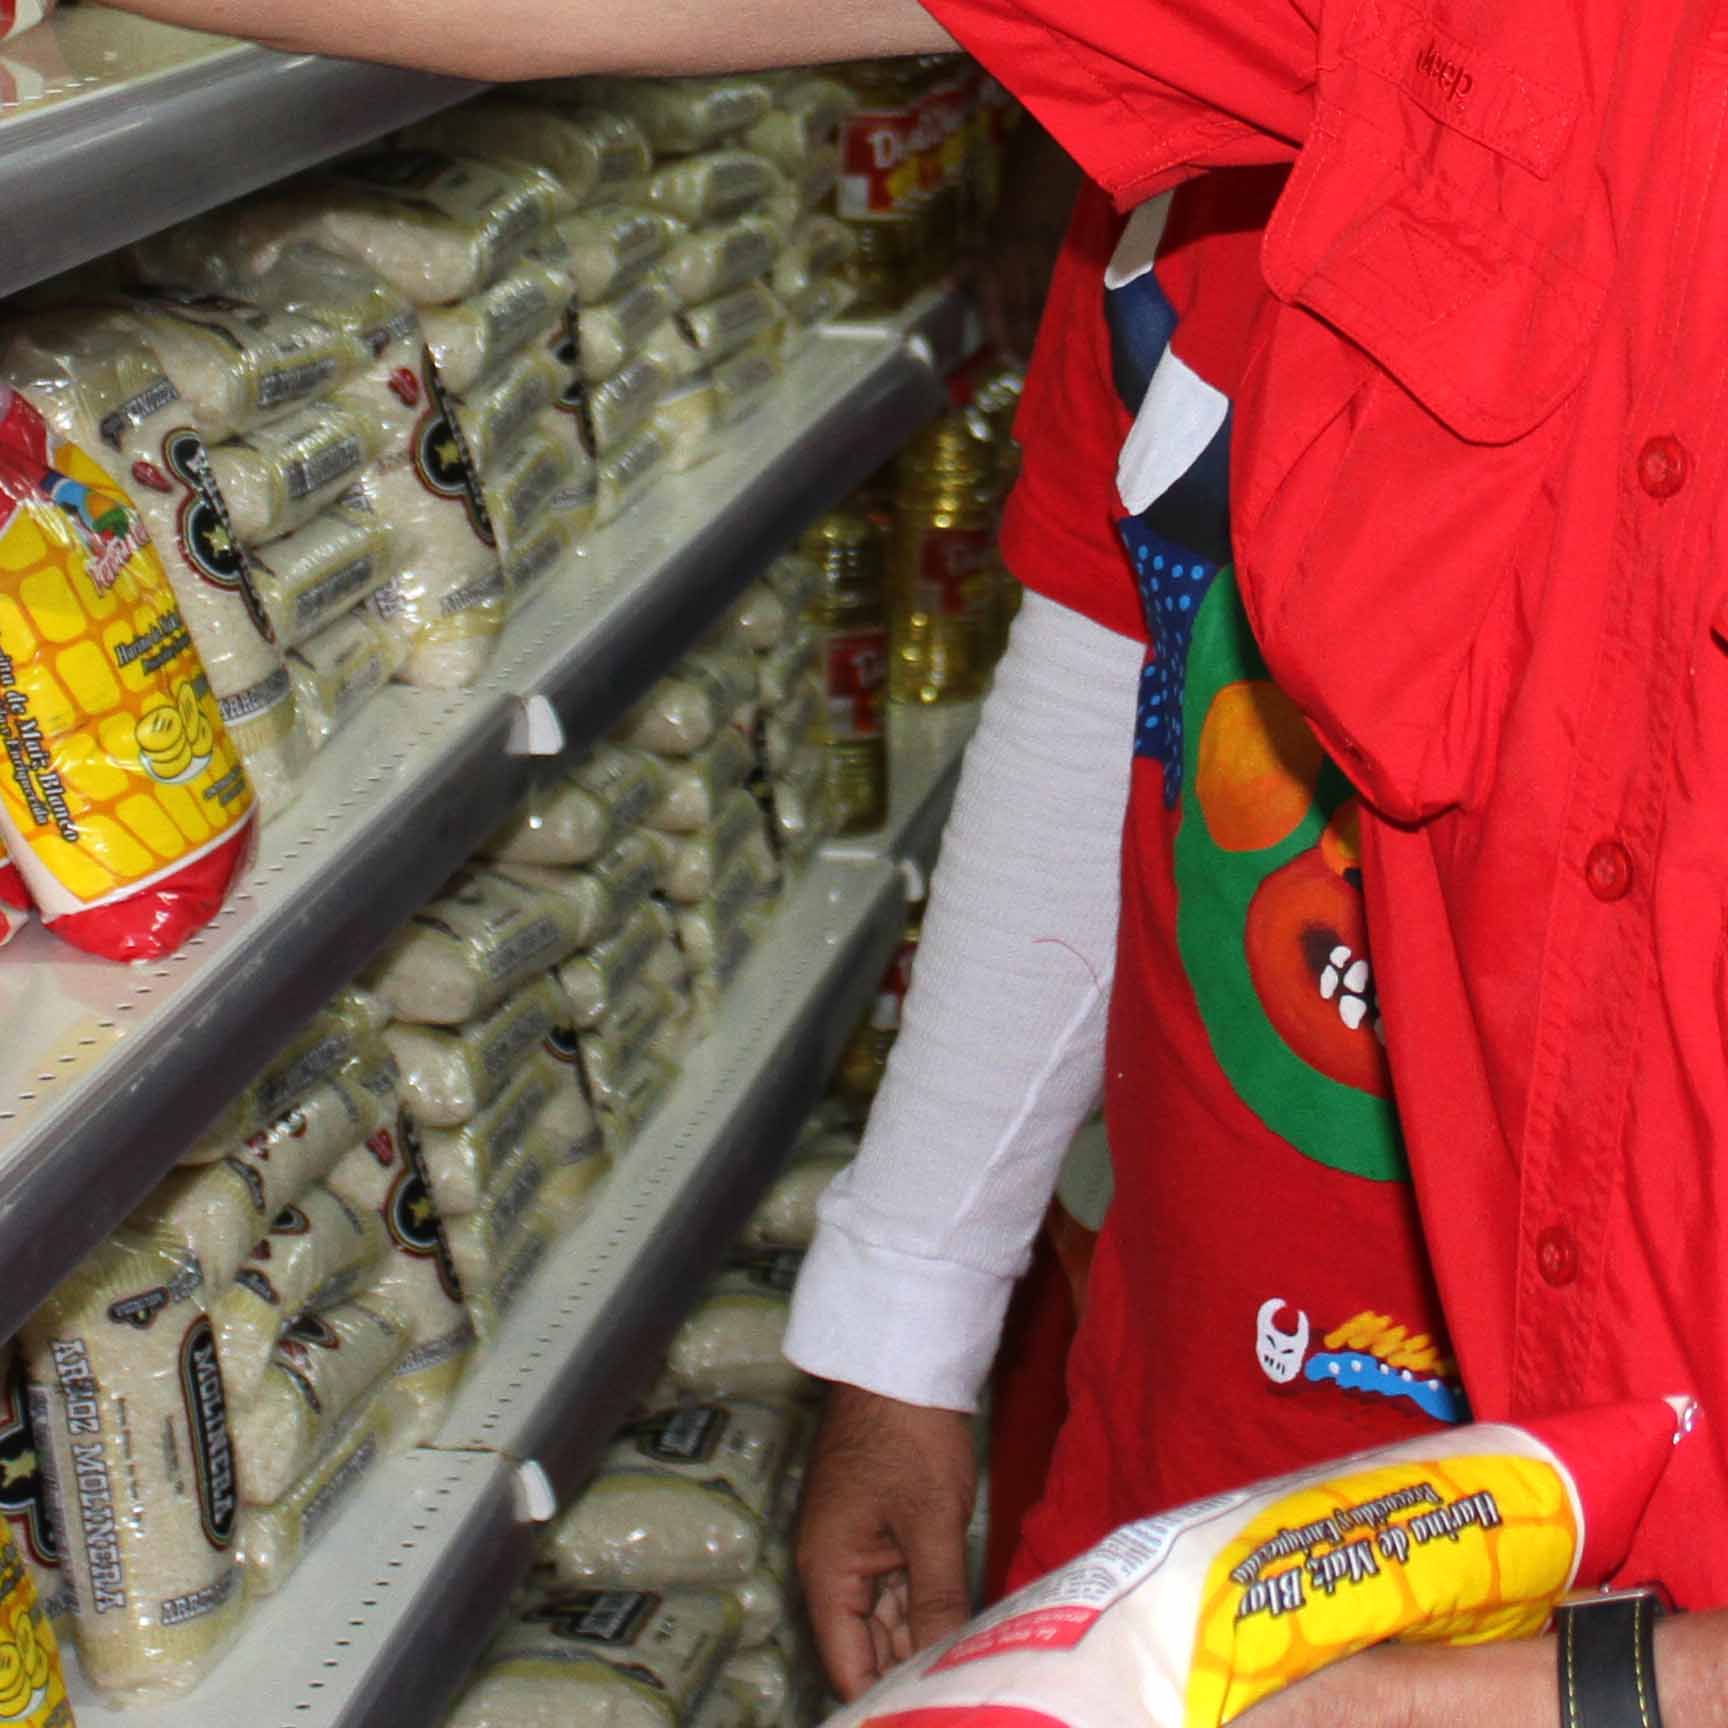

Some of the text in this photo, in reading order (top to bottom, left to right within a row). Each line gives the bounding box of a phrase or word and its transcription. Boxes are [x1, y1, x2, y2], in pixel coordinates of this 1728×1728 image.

[3, 688, 29, 716] de
[38, 770, 80, 844] Blanco
[72, 1443, 128, 1614] MOLINERA
[1377, 1527, 1410, 1564] de
[1409, 1491, 1501, 1545] Harina
